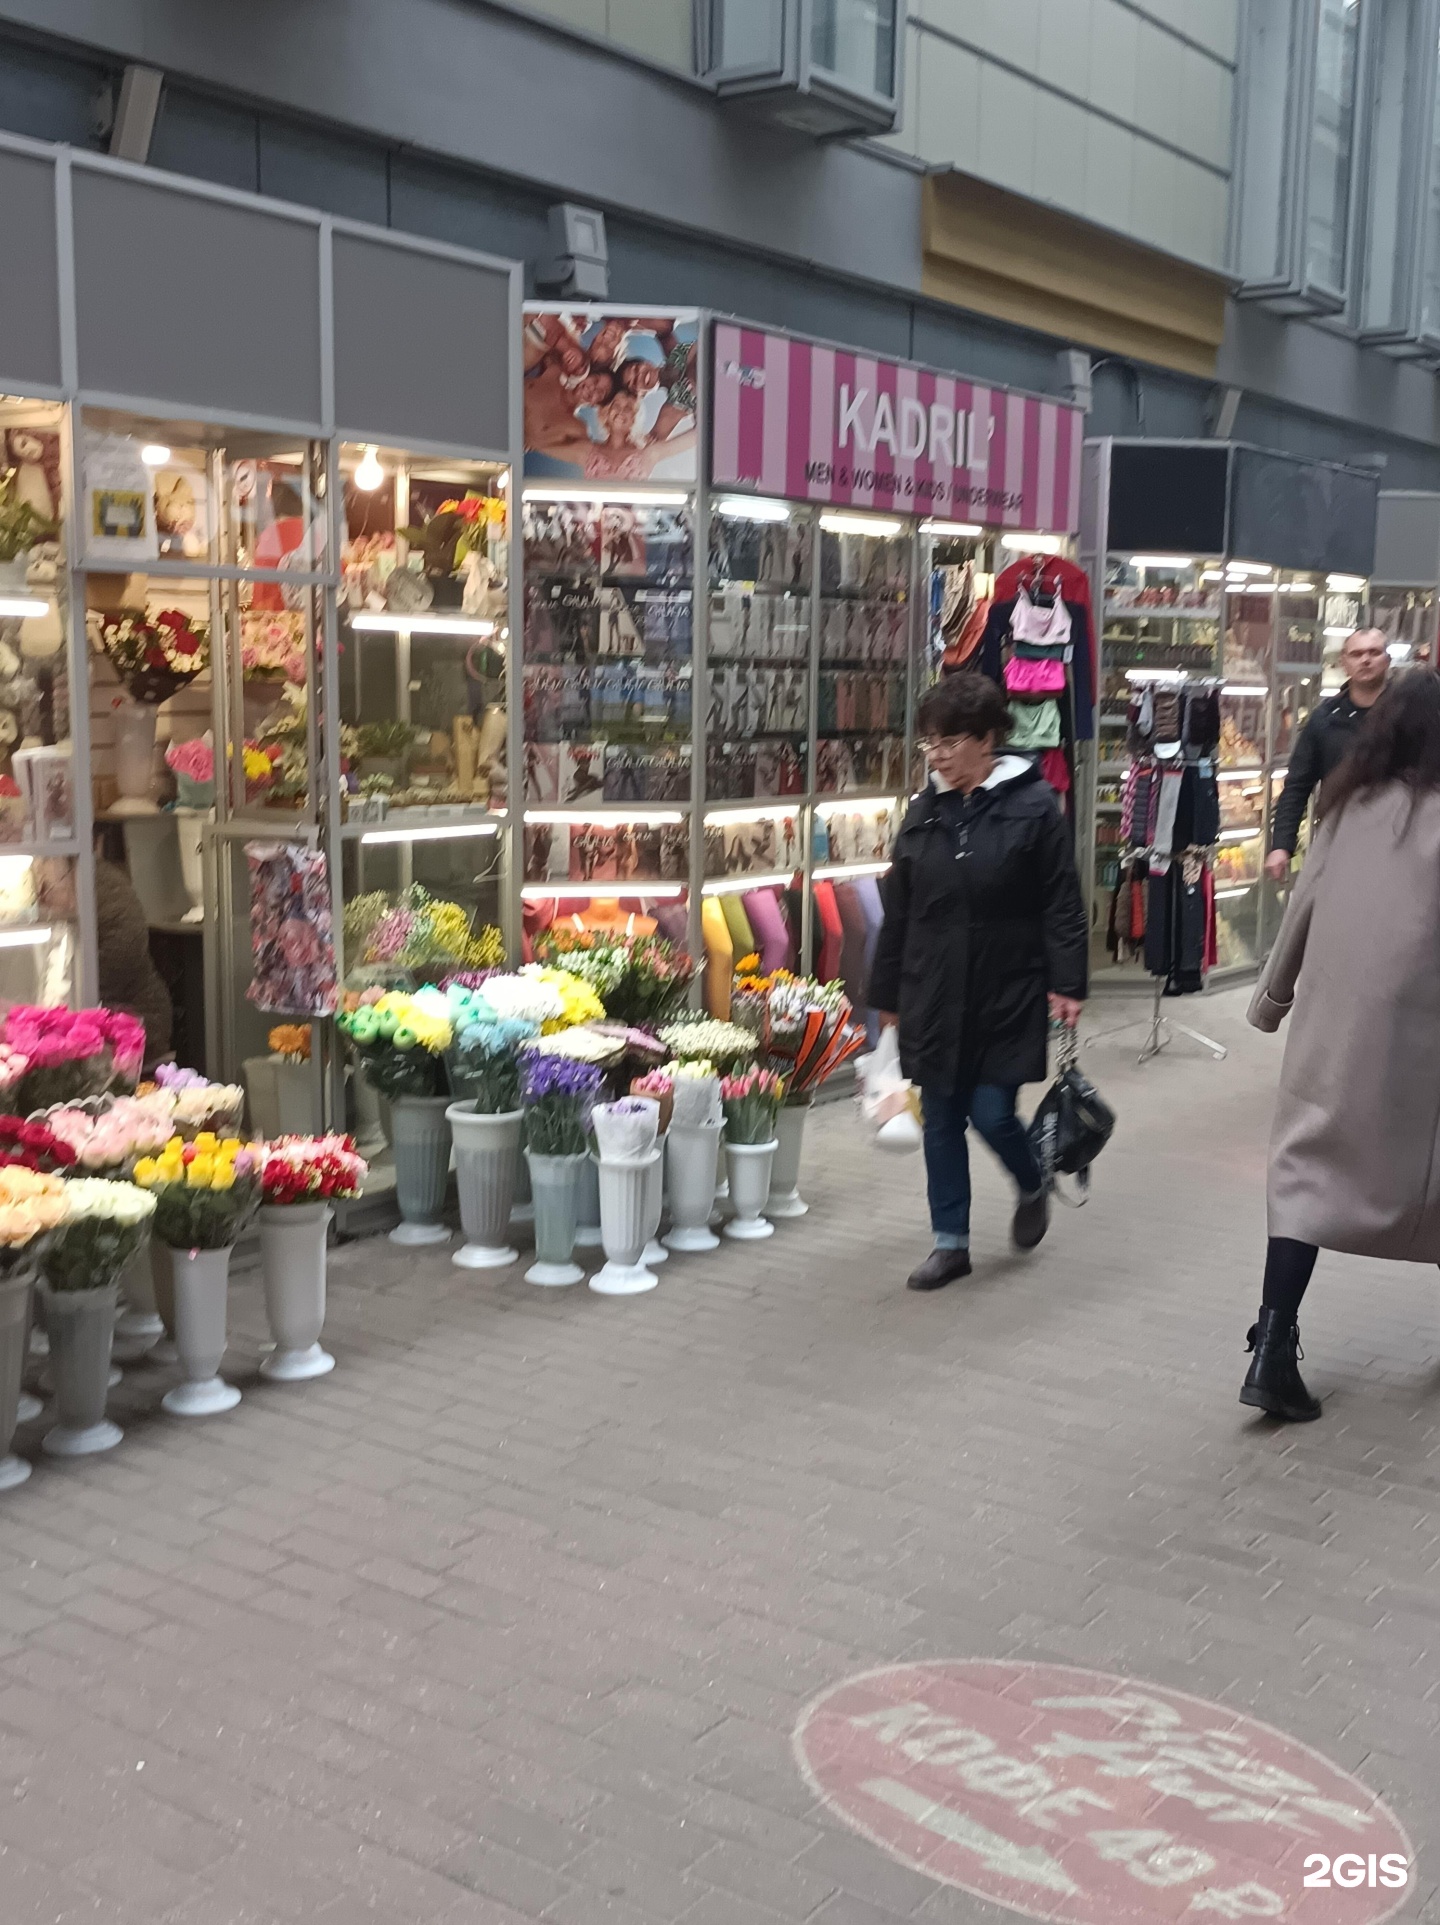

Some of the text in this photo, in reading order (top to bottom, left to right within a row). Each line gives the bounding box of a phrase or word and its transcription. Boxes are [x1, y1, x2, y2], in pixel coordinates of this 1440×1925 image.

[804, 461, 835, 484] MEN
[839, 466, 849, 488] &
[852, 467, 902, 494] WOMEN
[903, 476, 915, 496] &
[953, 483, 1024, 511] UNDERWEAR
[847, 1702, 1115, 1832] КОФЕ
[1086, 1829, 1217, 1886] 49
